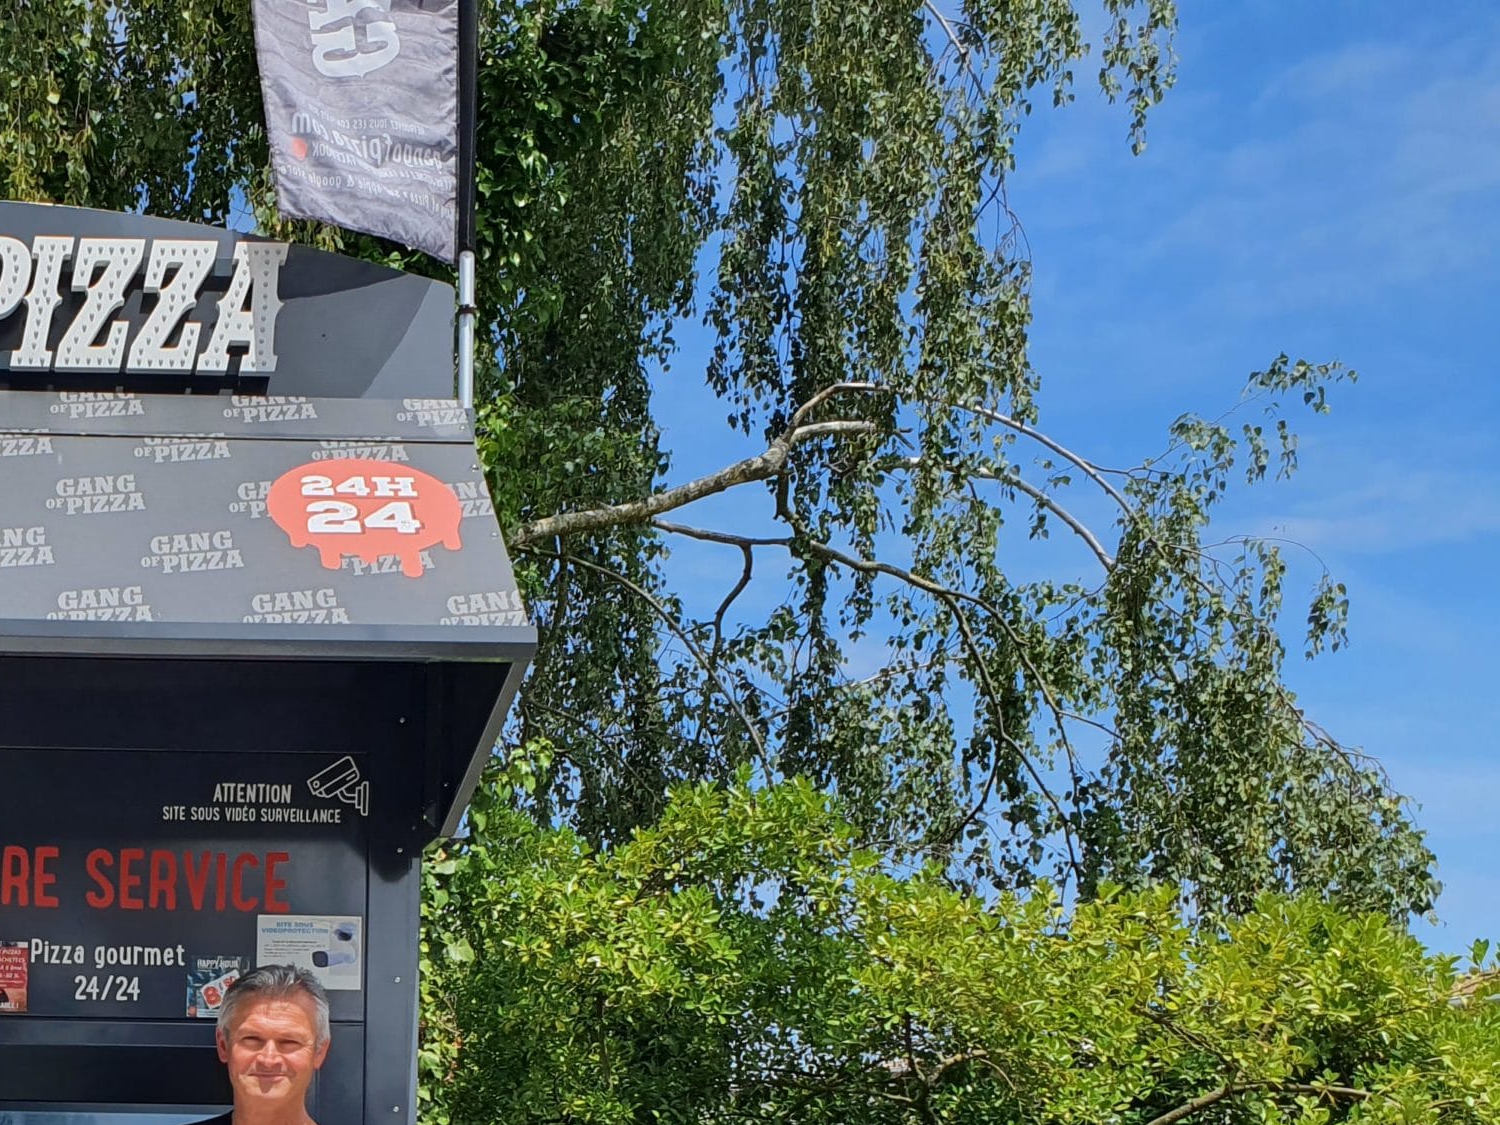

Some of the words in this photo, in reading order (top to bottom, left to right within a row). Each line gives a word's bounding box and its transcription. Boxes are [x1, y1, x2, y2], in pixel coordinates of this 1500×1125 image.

[300, 475, 418, 497] 24H
[305, 501, 422, 534] 24
[213, 783, 292, 804] ATTENTION
[162, 806, 186, 821] SITE
[190, 806, 220, 821] SOUS
[225, 805, 256, 822] VIDÉO
[260, 808, 341, 823] SURVEILLANCE
[85, 848, 290, 915] SERVICE
[30, 938, 85, 965] Pizza
[94, 941, 186, 970] gourmet
[74, 975, 141, 1002] 24/24
